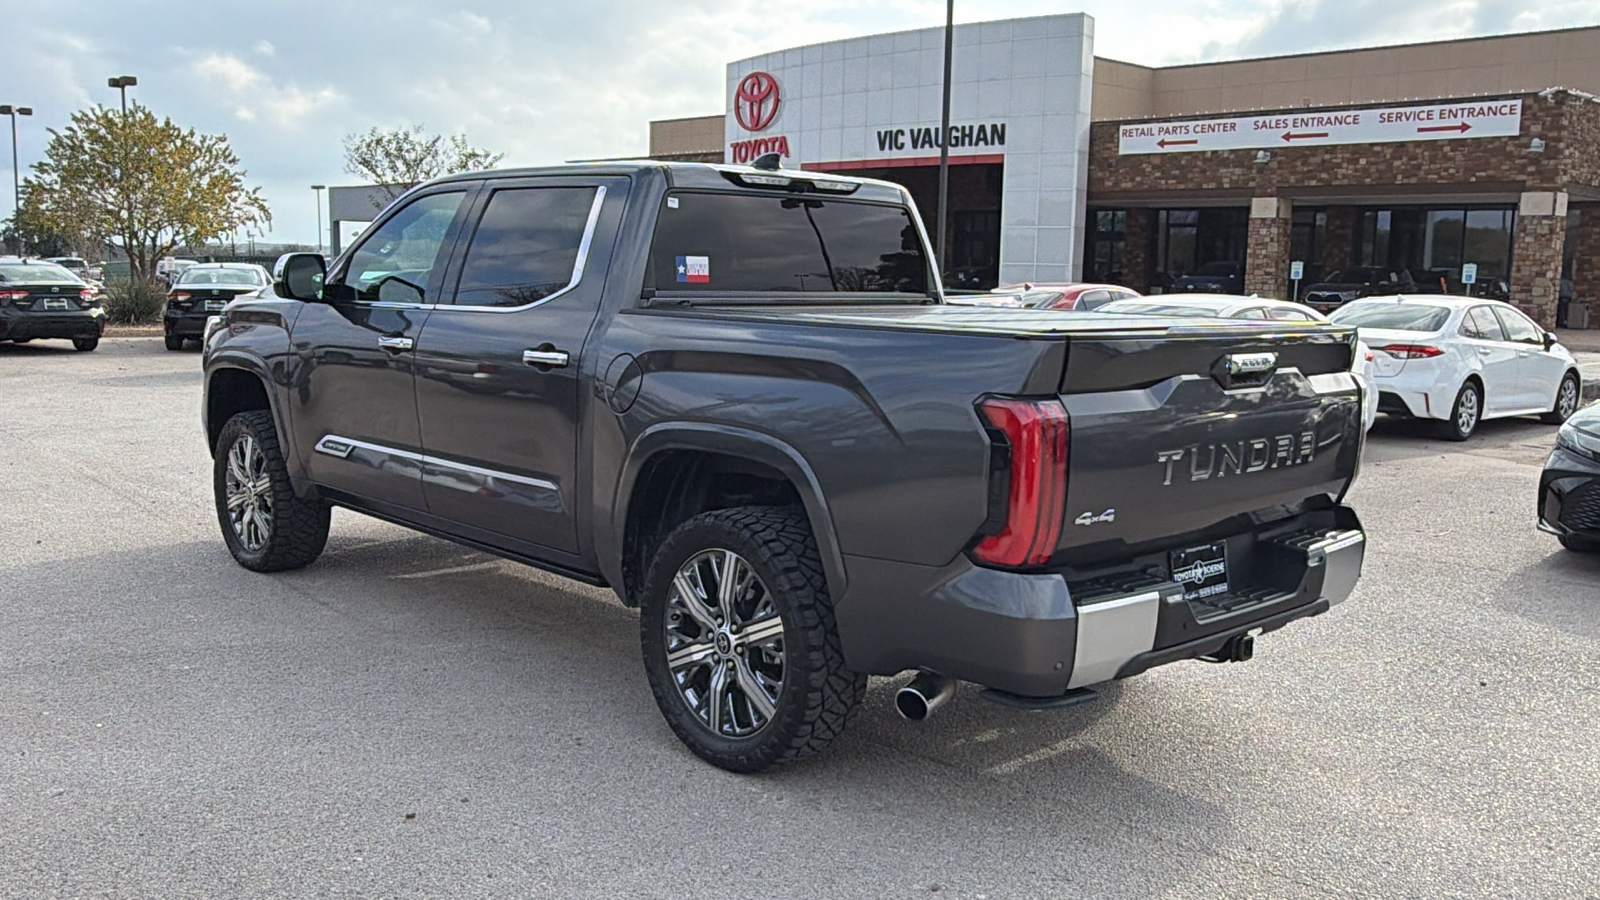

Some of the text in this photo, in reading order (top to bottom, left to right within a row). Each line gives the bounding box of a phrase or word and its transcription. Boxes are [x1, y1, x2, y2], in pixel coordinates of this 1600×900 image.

[1253, 114, 1361, 130] SALES ENTRANCE
[1378, 104, 1518, 123] SERVICE ENTRANCE
[877, 123, 1006, 151] VIC VAUGHAN
[1121, 122, 1237, 138] RETAIL PARTS CENTER
[730, 135, 790, 164] TOYOTA
[1157, 431, 1316, 486] TUNDRA
